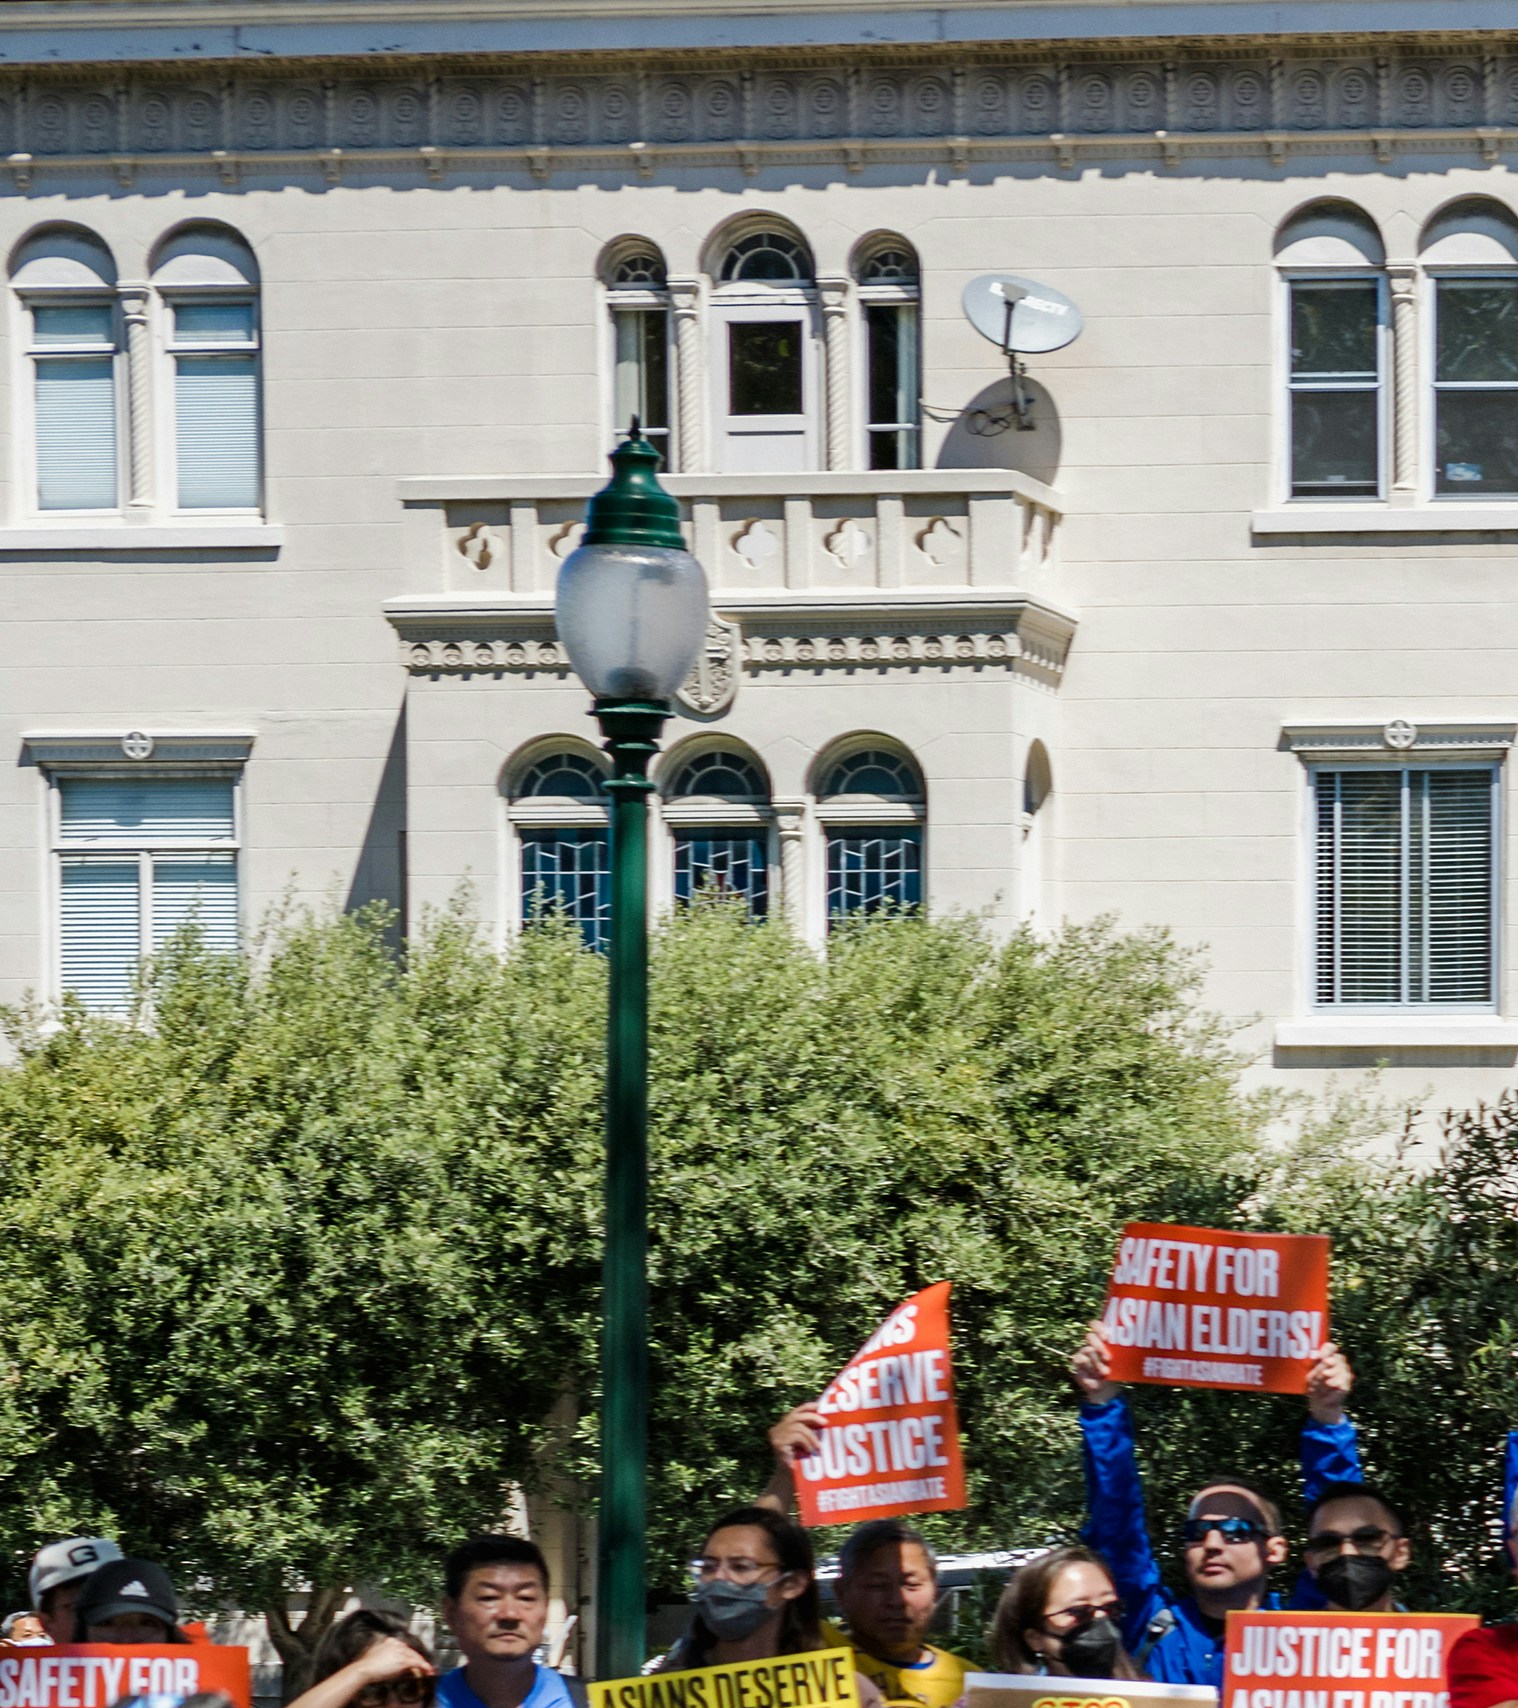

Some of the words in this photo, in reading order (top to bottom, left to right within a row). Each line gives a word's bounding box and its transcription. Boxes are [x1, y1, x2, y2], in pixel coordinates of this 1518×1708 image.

[1114, 1237, 1214, 1292] SAFETY
[1215, 1246, 1280, 1297] FOR
[1102, 1296, 1187, 1350] ASIAN
[1191, 1305, 1323, 1360] ELDERS!
[816, 1350, 949, 1415] ESERVE
[0, 1656, 125, 1708] SAFETY
[129, 1658, 199, 1703] FOR
[1231, 1626, 1372, 1679] JUSTICE
[1375, 1628, 1443, 1679] FOR
